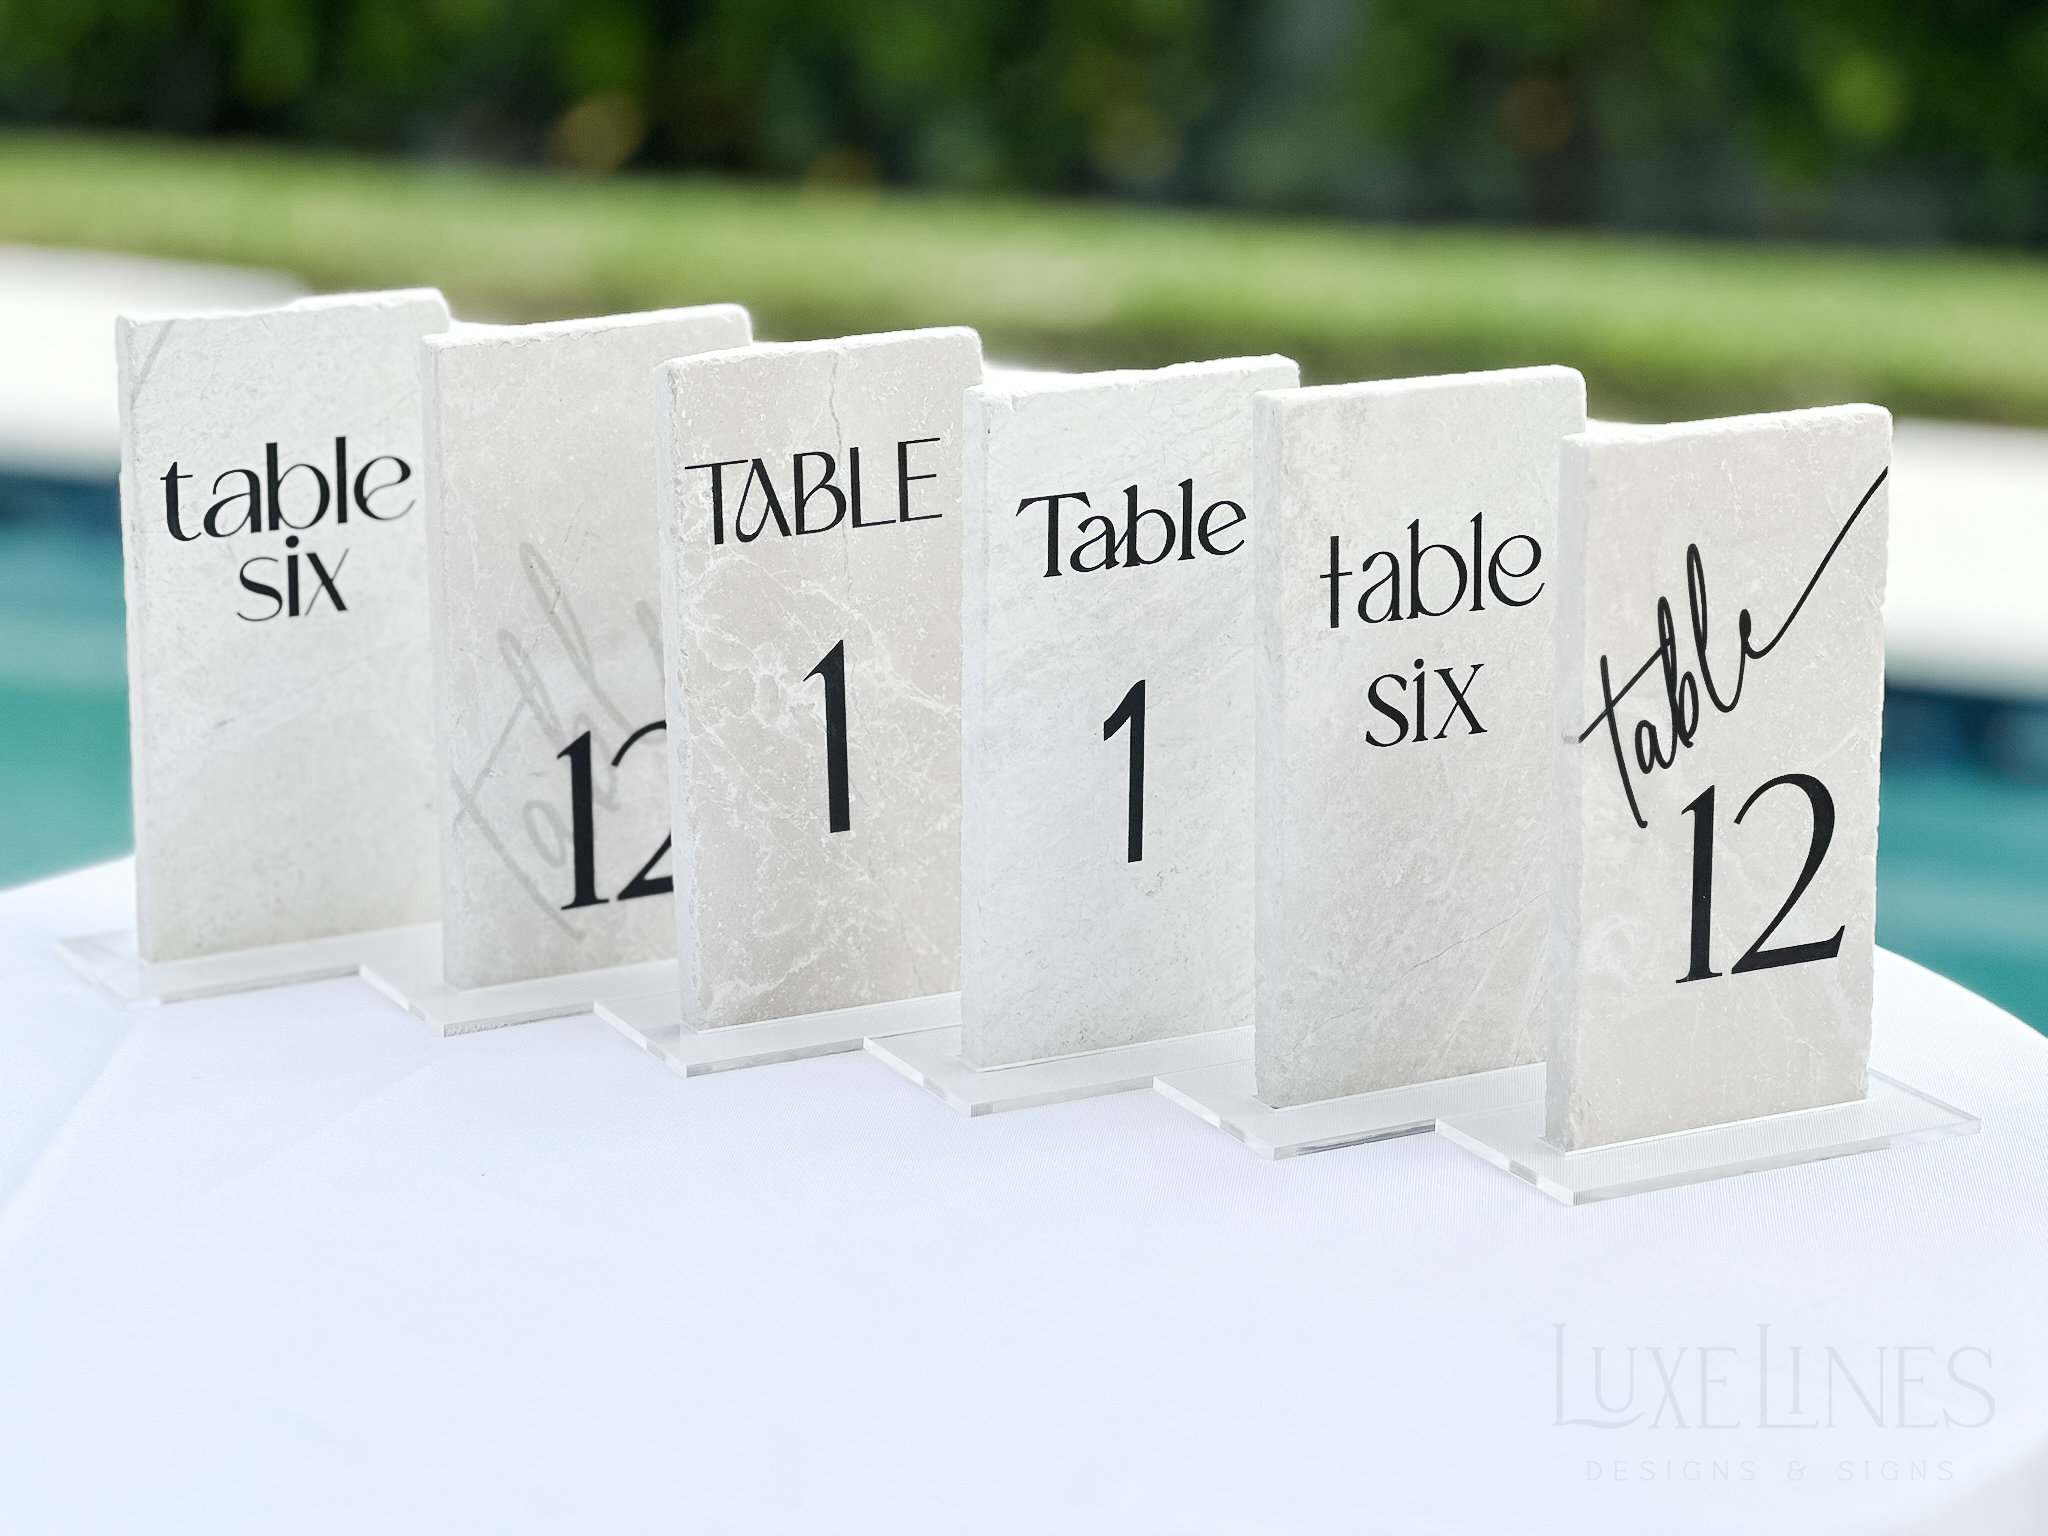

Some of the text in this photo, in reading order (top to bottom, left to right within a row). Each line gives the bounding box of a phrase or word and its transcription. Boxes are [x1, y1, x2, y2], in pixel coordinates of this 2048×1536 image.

[160, 437, 415, 541] table
[684, 437, 942, 545] TABLE
[1016, 478, 1246, 577] Table
[236, 536, 349, 622] six
[1319, 511, 1545, 628] table
[802, 640, 850, 834] 1
[1365, 658, 1488, 748] six
[1104, 680, 1146, 864] 1
[1675, 773, 1846, 984] 12
